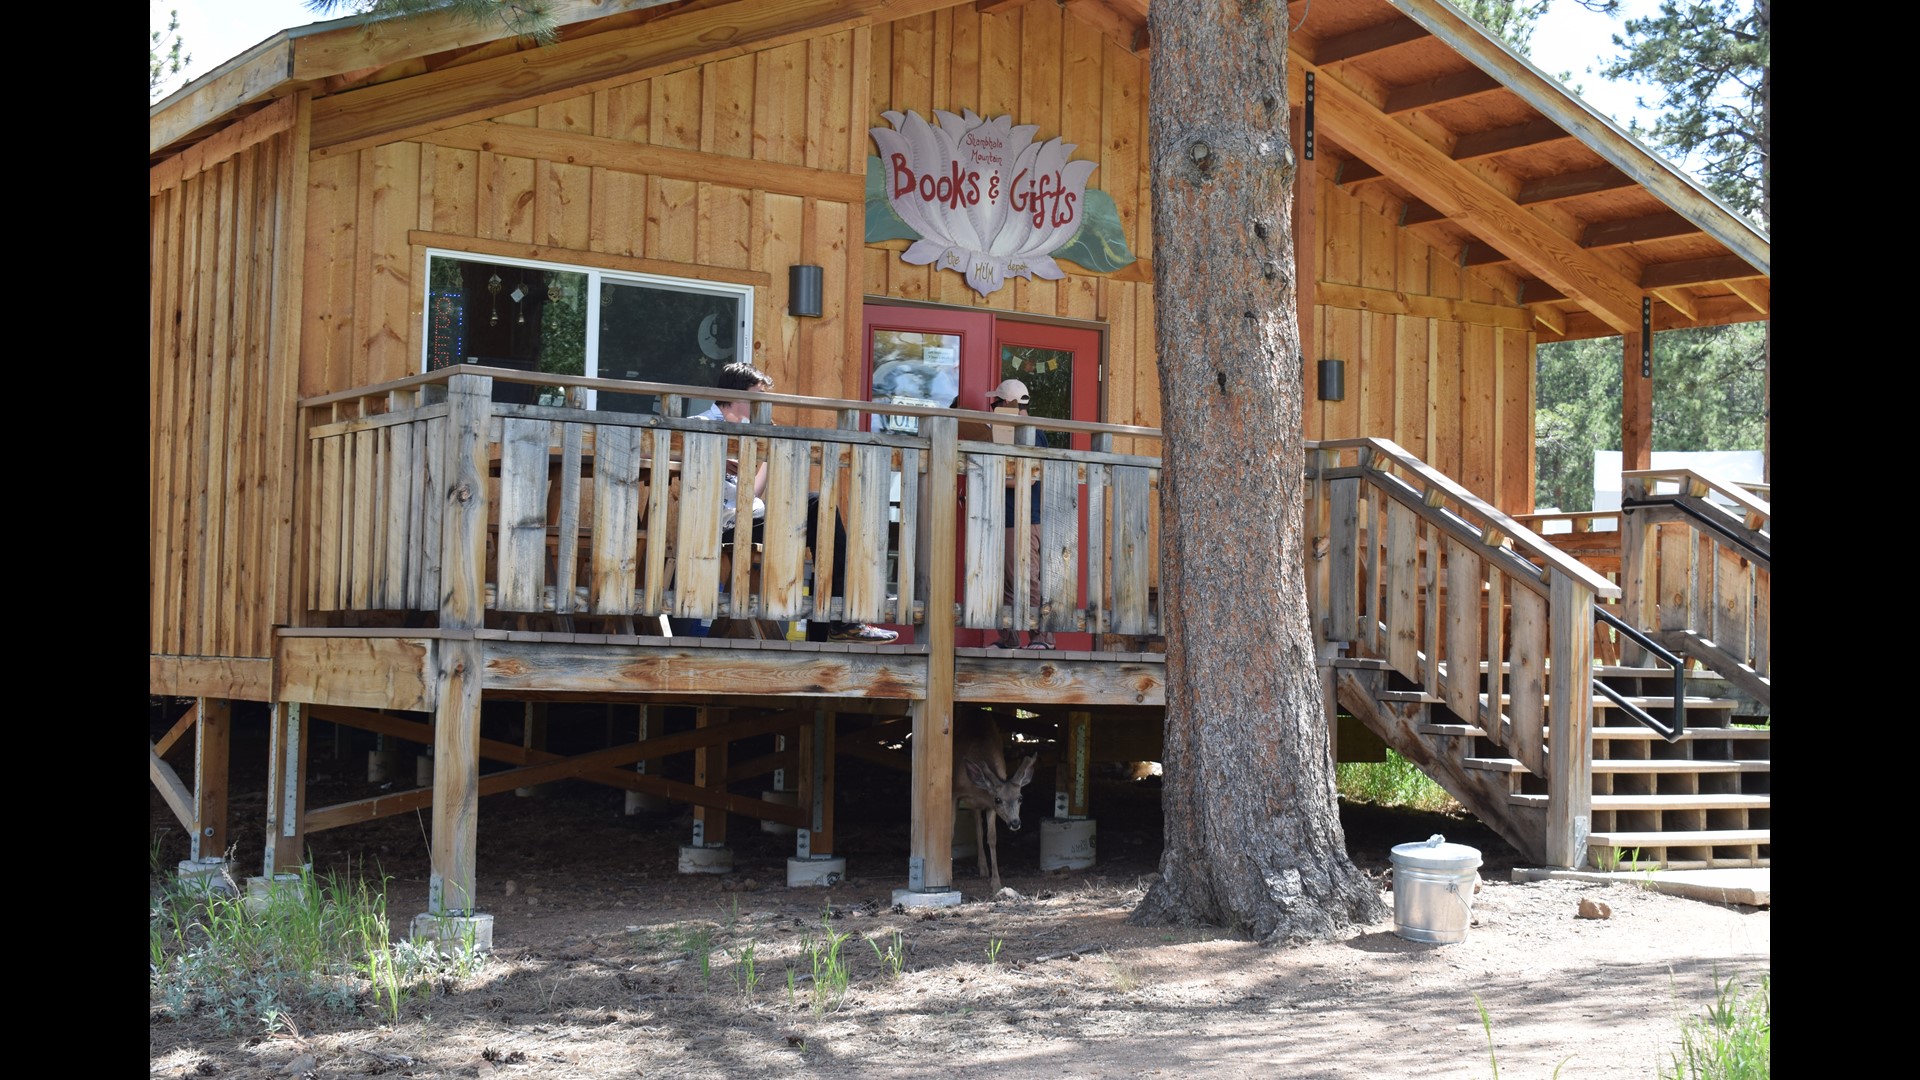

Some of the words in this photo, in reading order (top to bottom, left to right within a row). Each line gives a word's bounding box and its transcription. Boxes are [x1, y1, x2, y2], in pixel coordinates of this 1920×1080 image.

[971, 150, 1003, 166] Mountain
[891, 153, 981, 210] Books
[1009, 168, 1077, 229] Gifts
[946, 250, 961, 267] the
[1007, 259, 1029, 275] depot
[433, 297, 451, 371] OPEN
